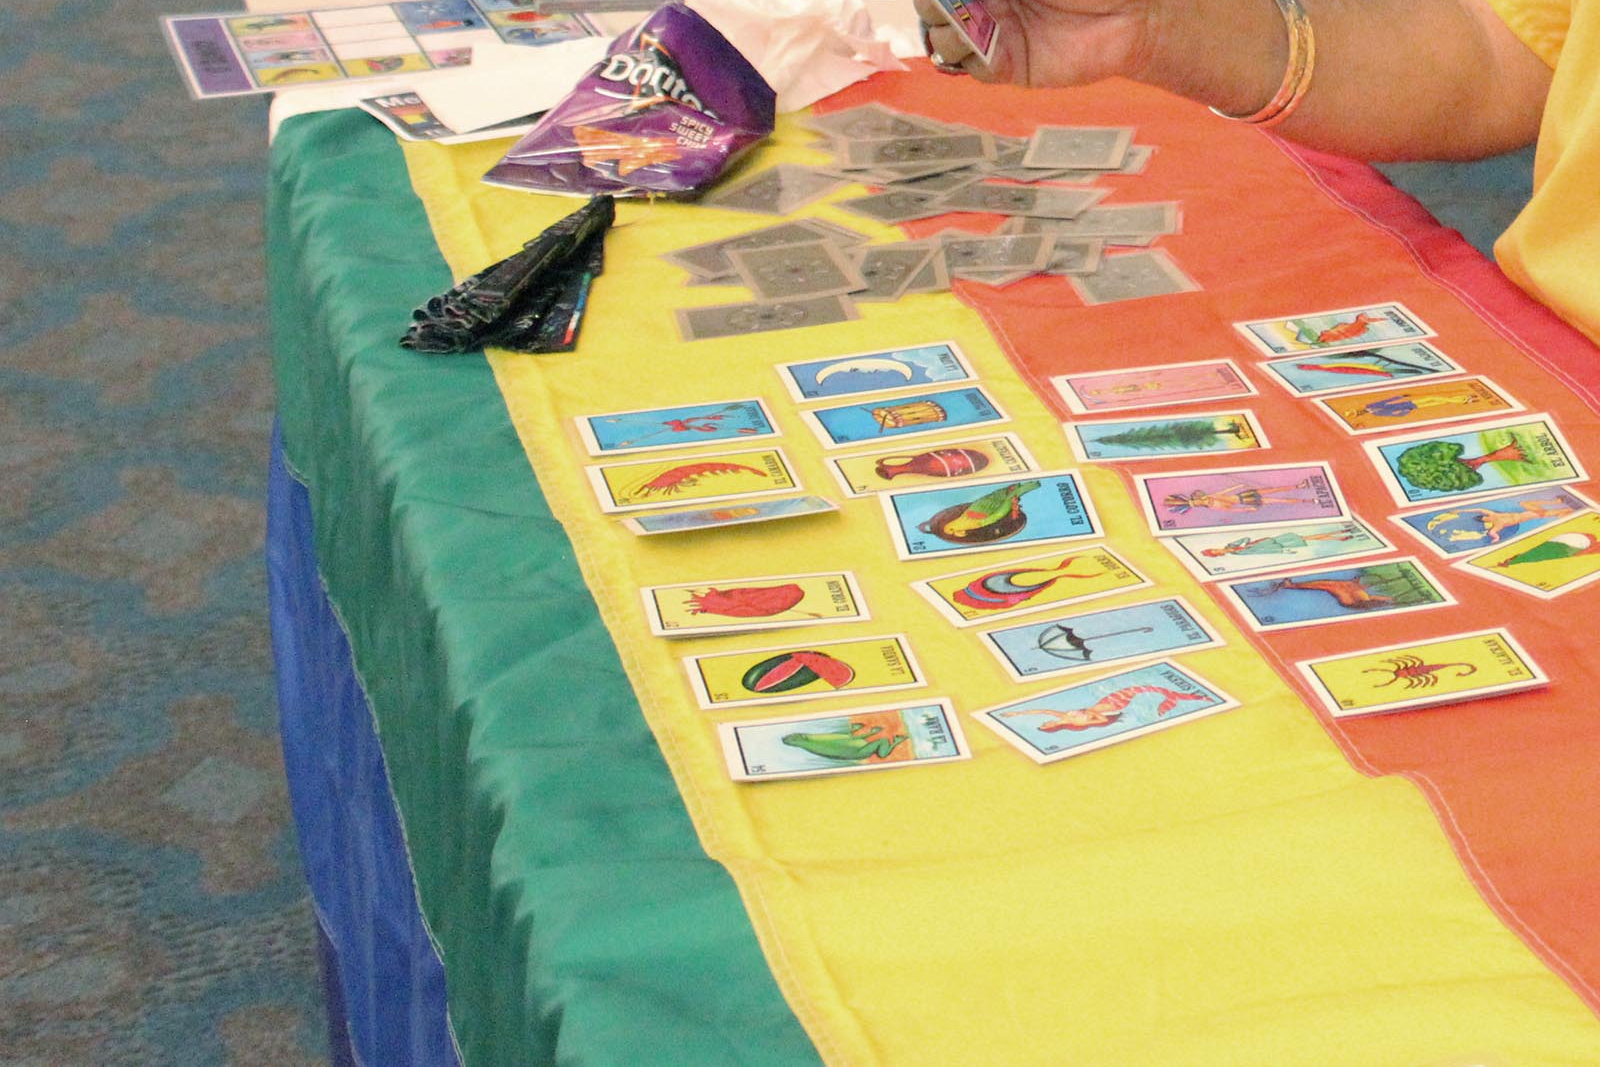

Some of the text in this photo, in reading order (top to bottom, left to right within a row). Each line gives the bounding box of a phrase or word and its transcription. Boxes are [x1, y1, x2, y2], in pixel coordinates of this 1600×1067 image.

[669, 122, 709, 144] SWEET
[680, 115, 713, 135] SPICY
[1056, 482, 1079, 514] COTORRO
